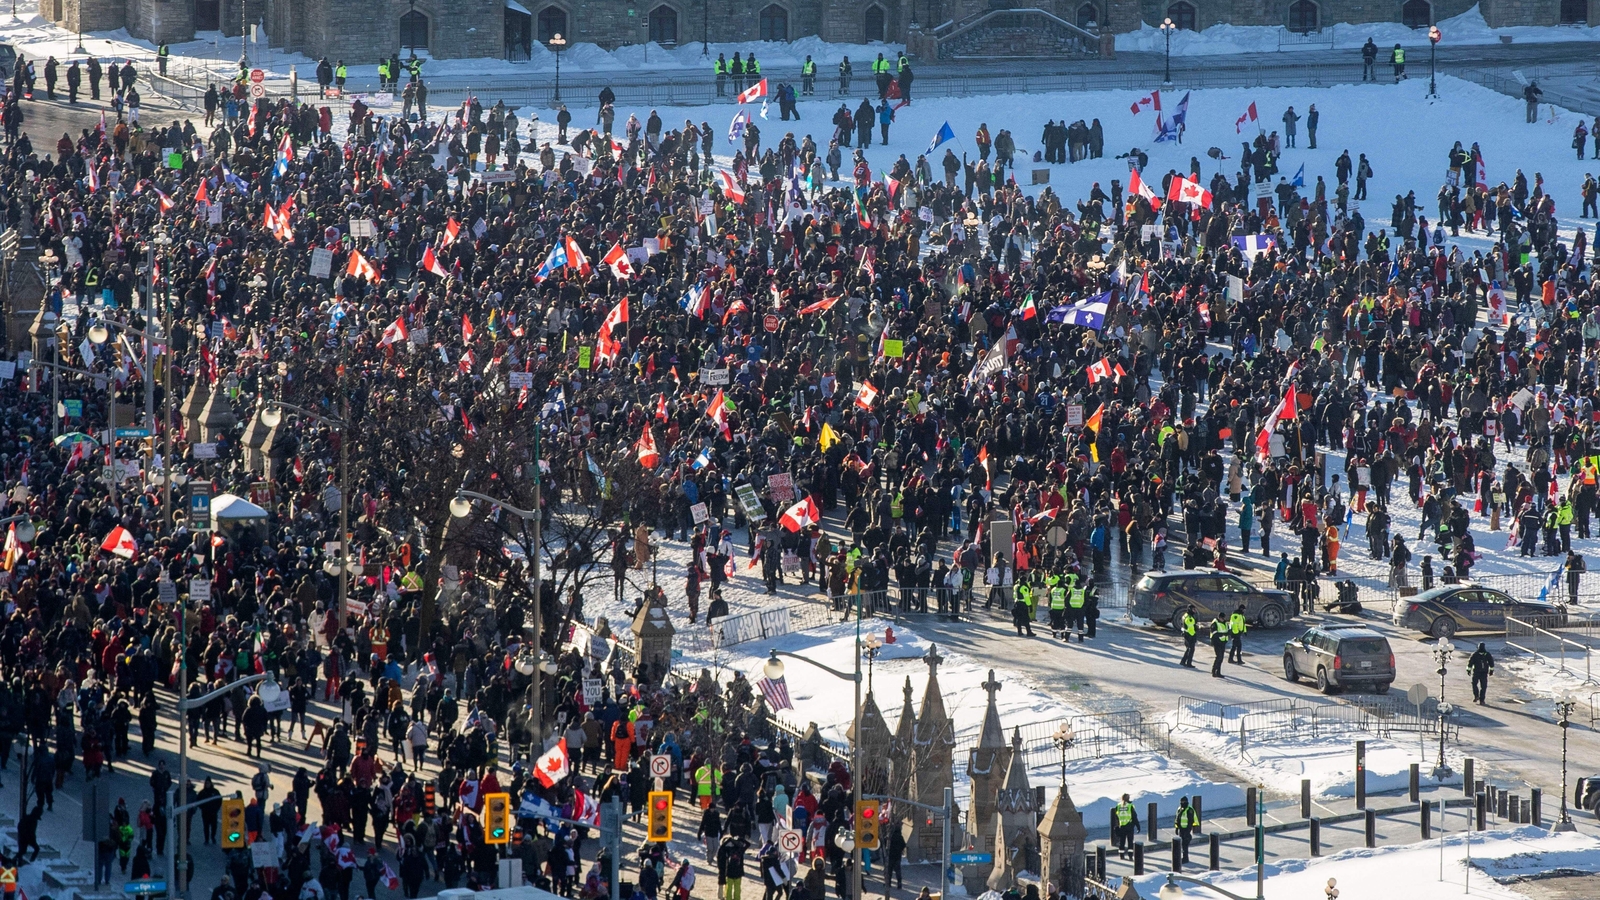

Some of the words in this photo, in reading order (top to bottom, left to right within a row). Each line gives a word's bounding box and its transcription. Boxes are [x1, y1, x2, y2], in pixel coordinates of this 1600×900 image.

[1040, 397, 1048, 406] 21
[585, 687, 601, 696] YOU
[139, 883, 151, 891] Elgin
